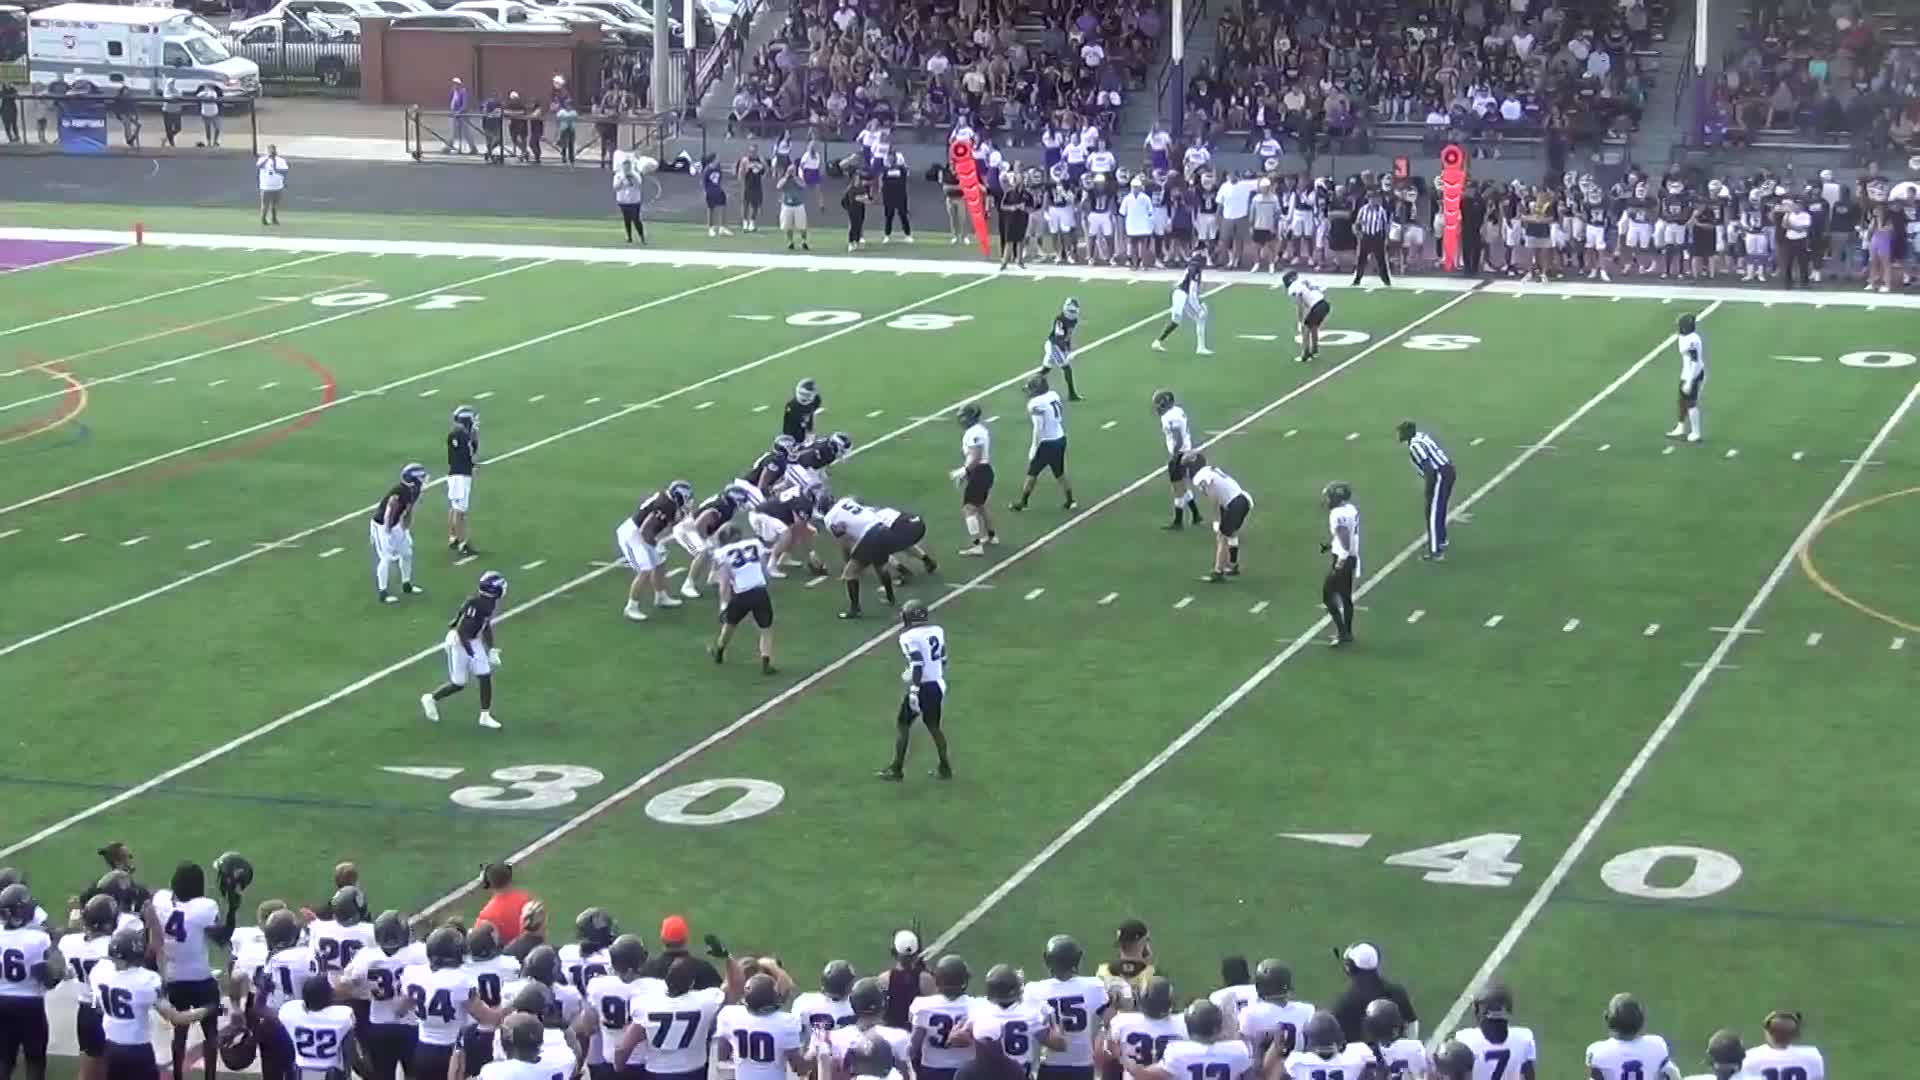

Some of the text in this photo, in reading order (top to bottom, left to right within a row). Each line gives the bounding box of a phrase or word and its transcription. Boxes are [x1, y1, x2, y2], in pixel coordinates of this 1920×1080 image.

[165, 910, 187, 944] 4
[0, 948, 27, 984] 6
[97, 984, 136, 1020] 16
[601, 996, 633, 1030] 9
[294, 1026, 337, 1060] 22
[647, 1010, 702, 1050] 77
[732, 1028, 775, 1064] 10
[928, 1013, 966, 1050] 3
[1004, 1020, 1029, 1057] 6
[1484, 1048, 1511, 1080] 7
